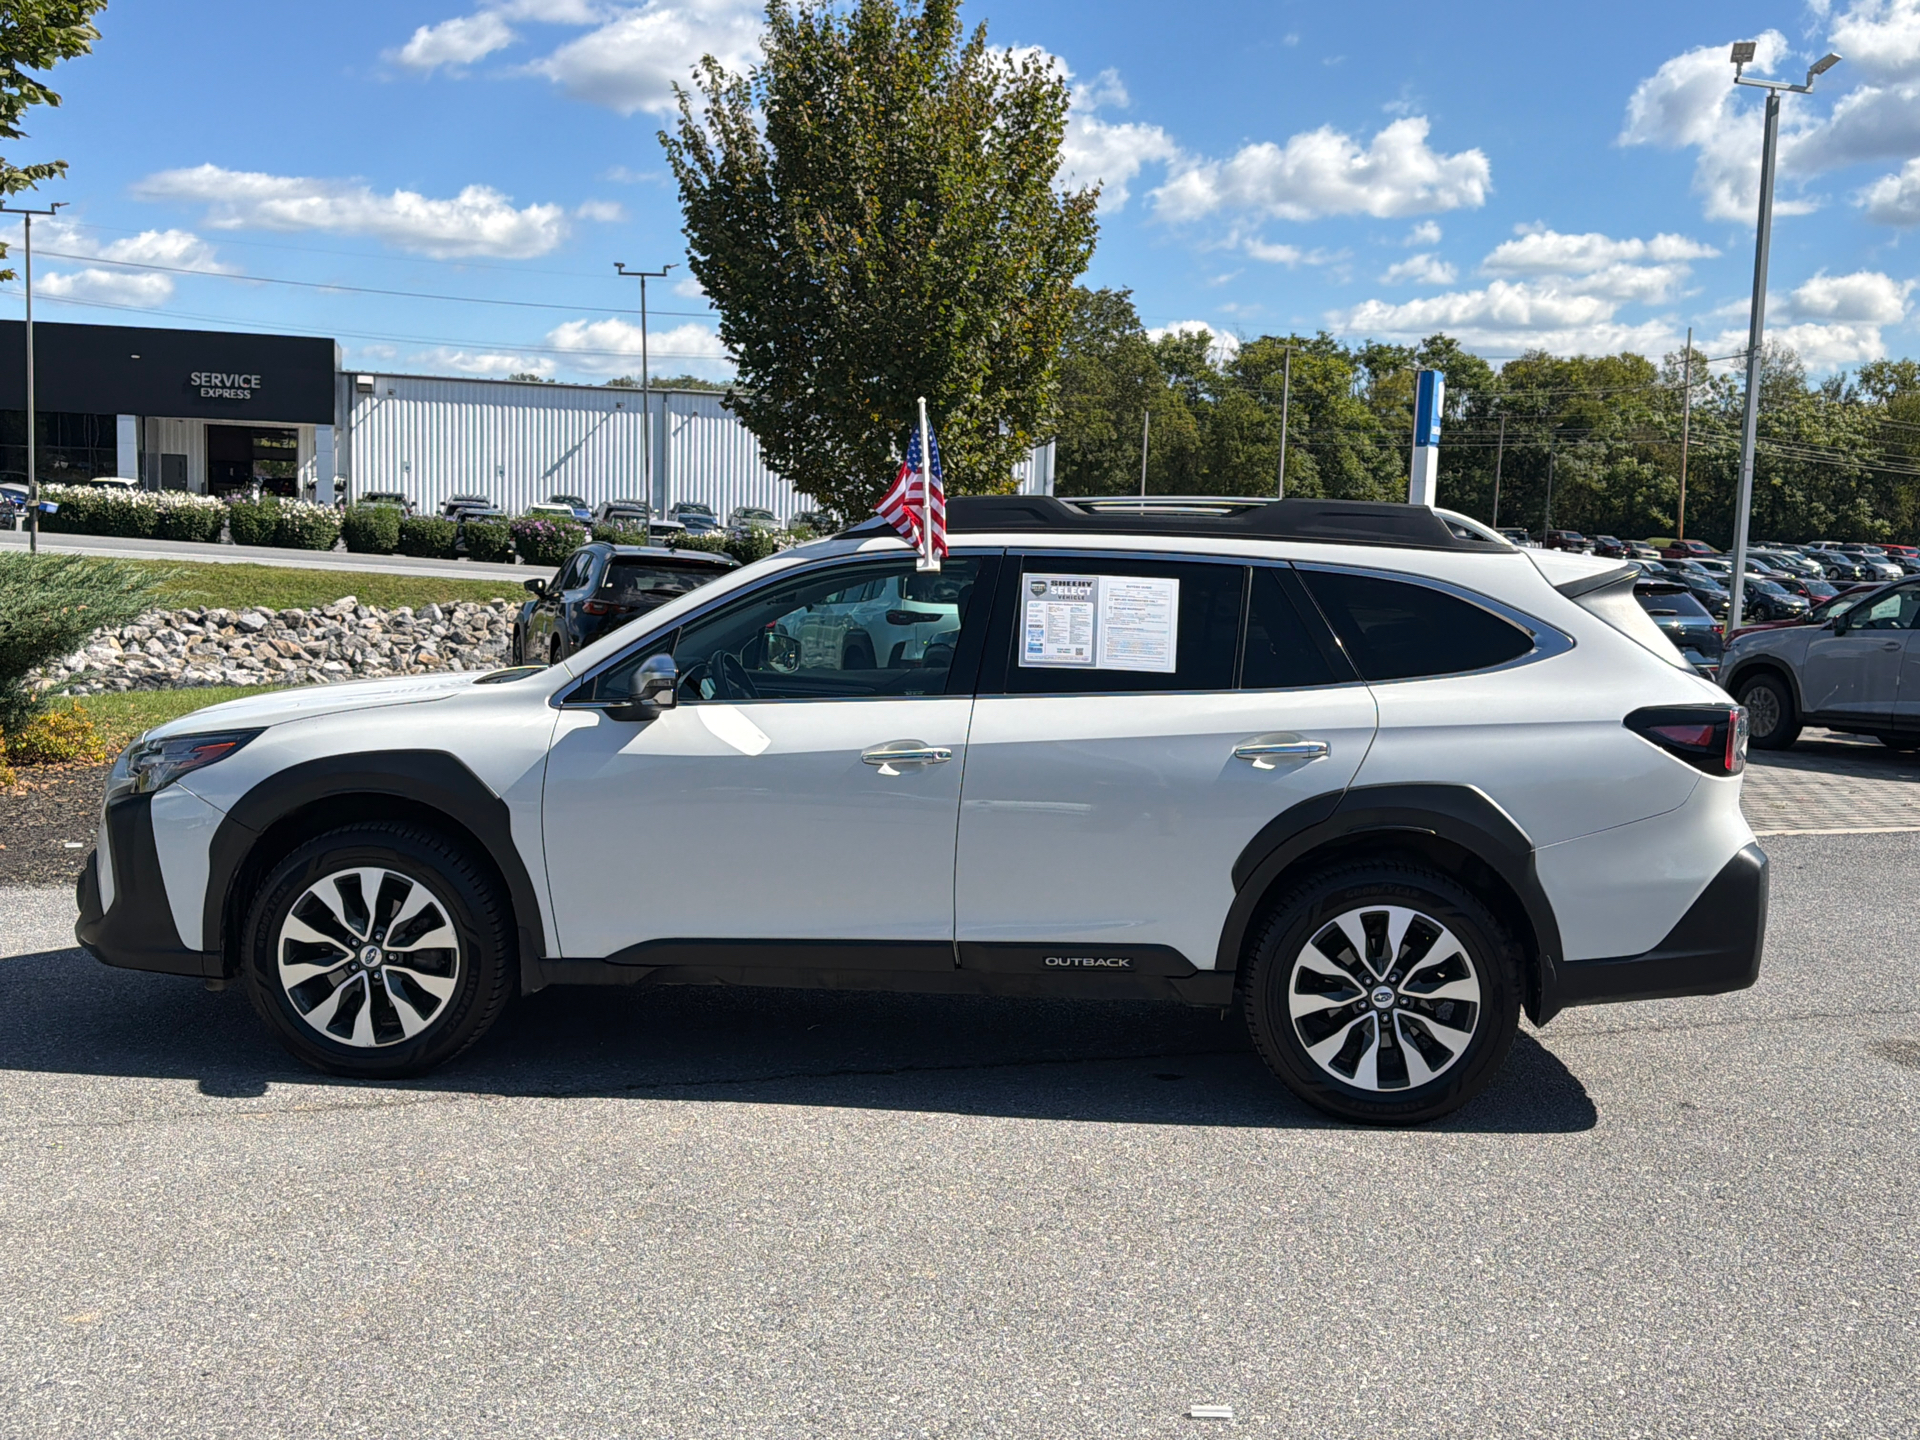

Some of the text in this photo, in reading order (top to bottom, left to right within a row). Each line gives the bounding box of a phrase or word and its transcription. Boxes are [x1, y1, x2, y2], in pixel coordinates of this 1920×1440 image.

[190, 371, 261, 389] SERVICE
[200, 387, 252, 400] EXPRESS
[1050, 586, 1093, 596] SELECT
[1045, 957, 1130, 967] OUTBACK
